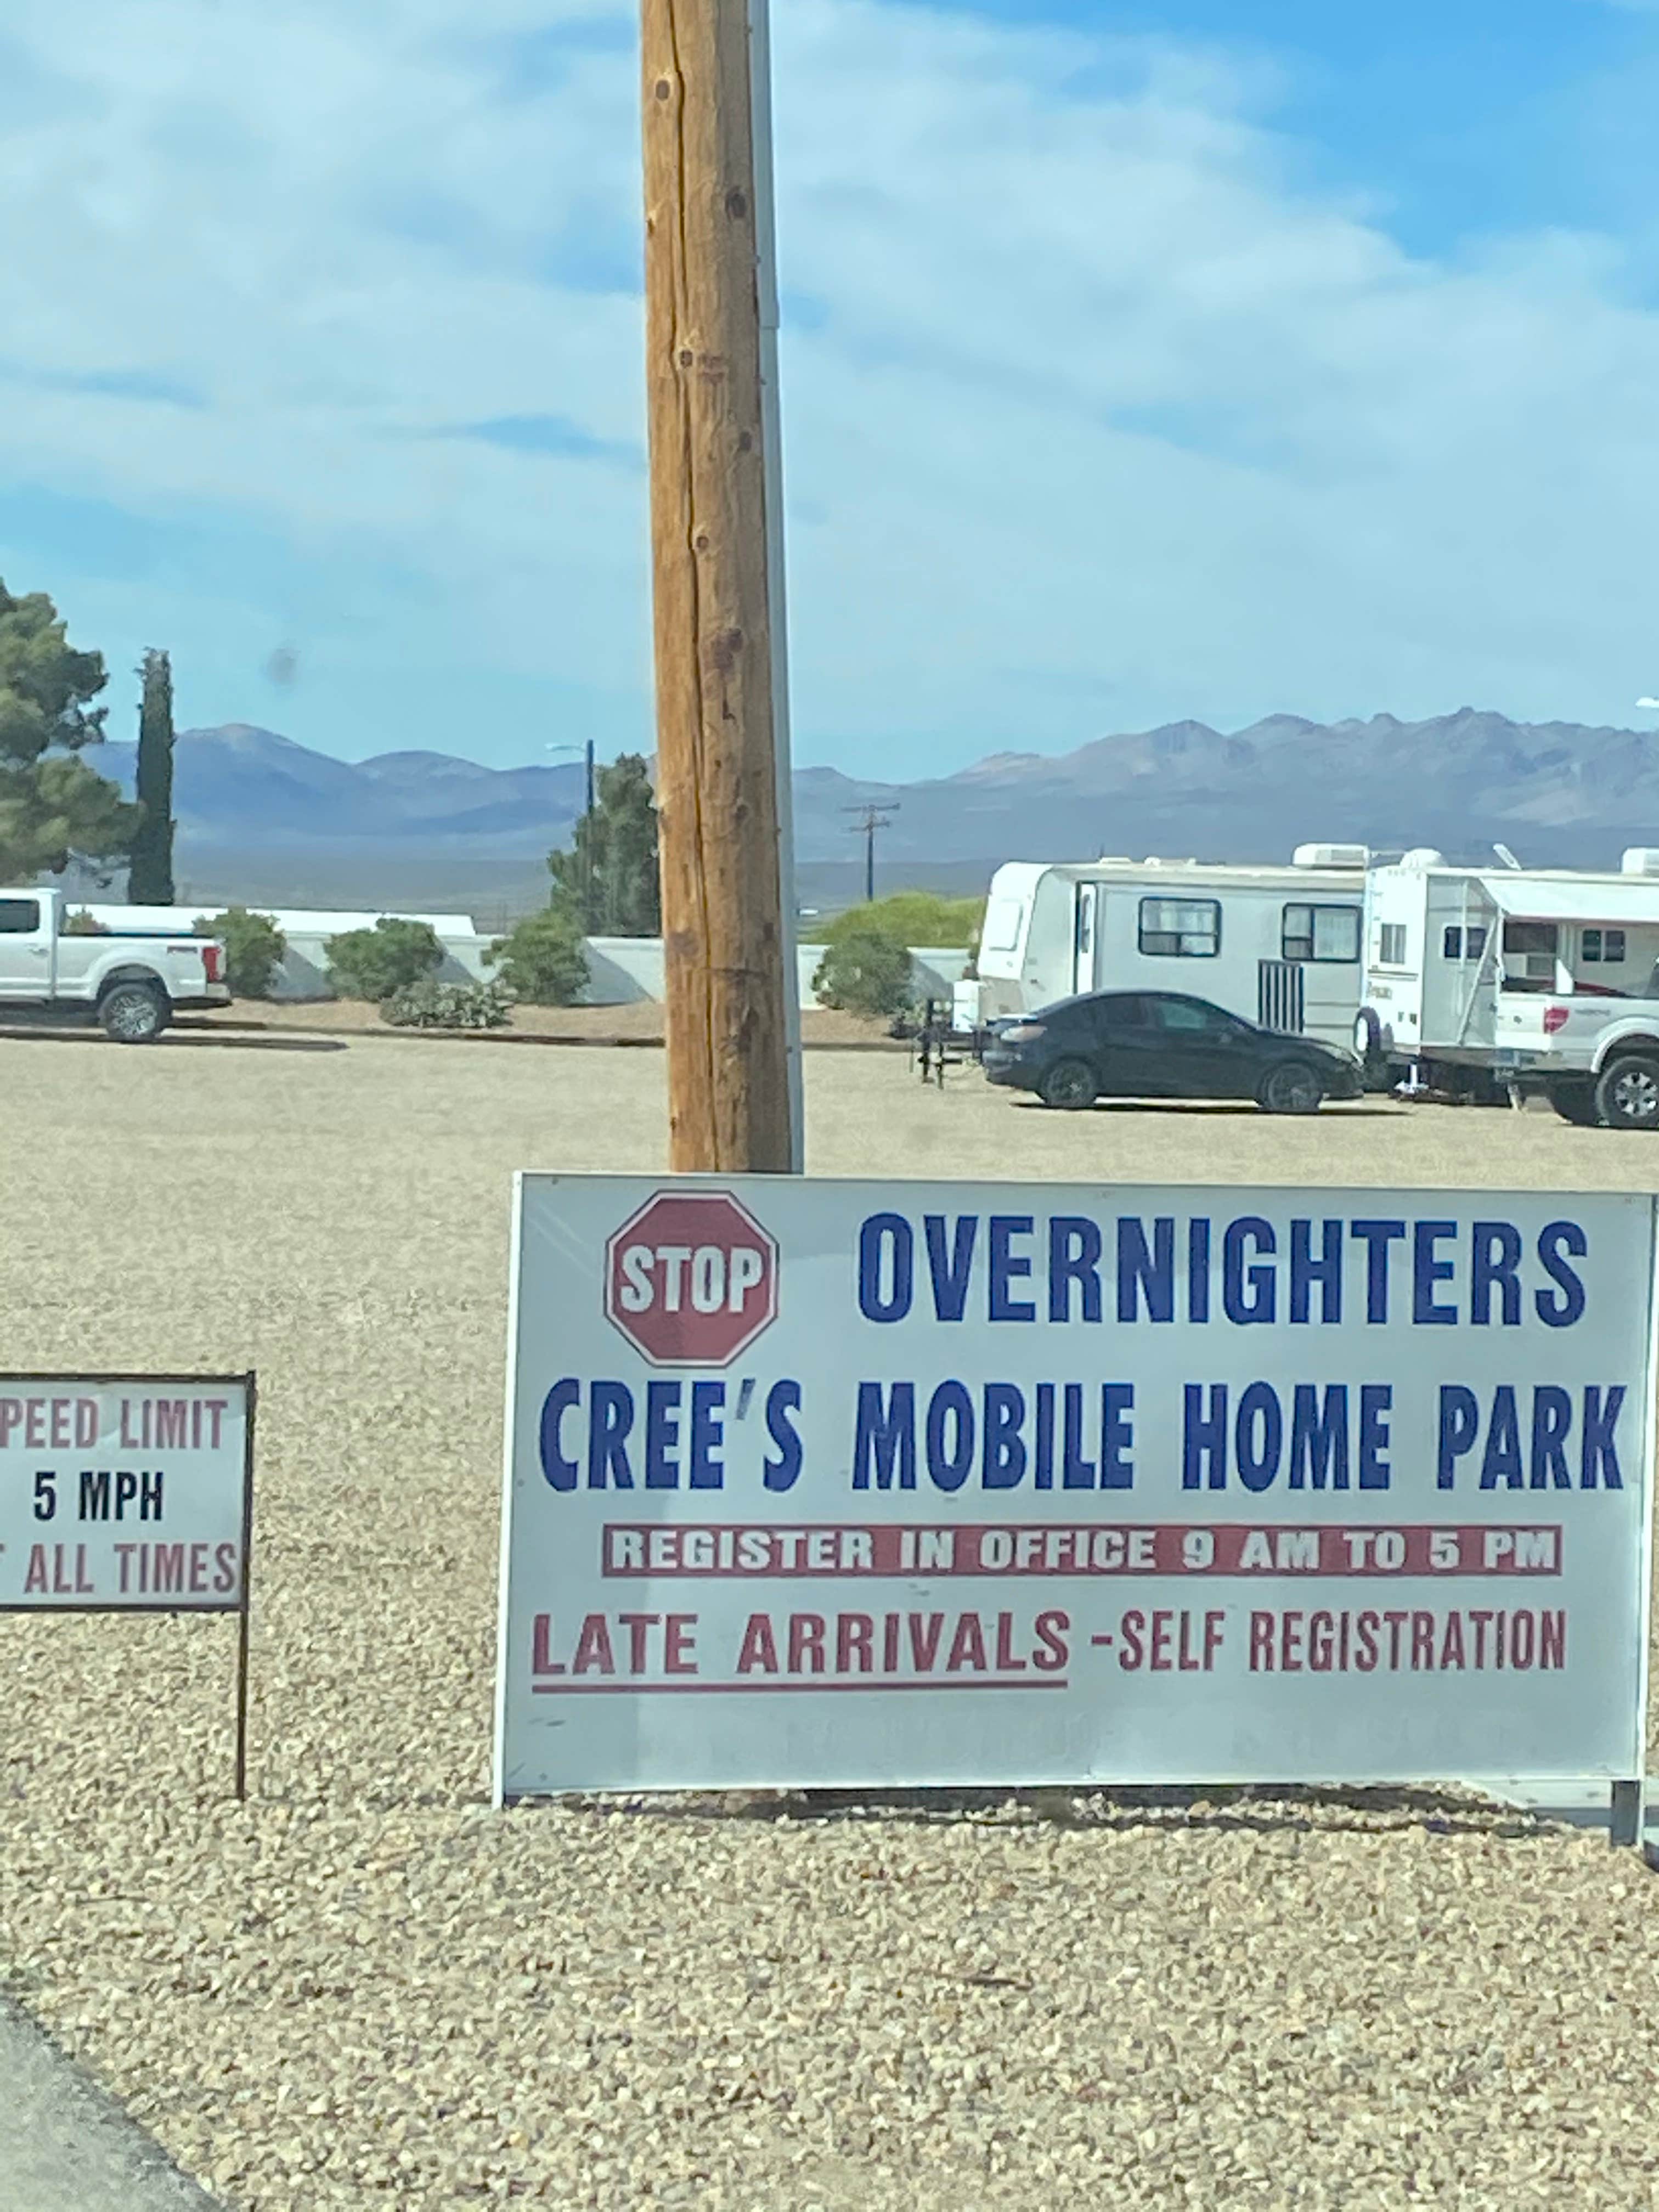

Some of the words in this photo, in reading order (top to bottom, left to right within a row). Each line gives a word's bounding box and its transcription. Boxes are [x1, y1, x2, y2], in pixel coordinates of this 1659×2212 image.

[620, 1244, 763, 1314] STOP
[858, 1211, 1588, 1329] OVERNIGHTERS
[0, 1398, 99, 1449] PEED
[120, 1399, 229, 1449] LIMIT
[539, 1377, 804, 1492] CREE'S
[851, 1379, 1134, 1492] MOBILE
[1182, 1381, 1393, 1492] HOME
[1436, 1384, 1628, 1491] PARK
[33, 1471, 56, 1521] 5
[78, 1471, 165, 1521] MPH
[23, 1544, 94, 1594] ALL
[113, 1543, 236, 1594] TIMES
[611, 1530, 873, 1570] REGISTER
[899, 1530, 955, 1570] IN
[978, 1530, 1156, 1570] OFFICE
[1182, 1530, 1214, 1570] 9
[1239, 1530, 1319, 1570] AM
[1342, 1530, 1406, 1570] TO
[1430, 1530, 1460, 1570] 5
[1482, 1530, 1556, 1570] PM
[532, 1612, 699, 1675] LATE
[735, 1610, 1071, 1675] ARRIVALS
[1248, 1609, 1566, 1672] REGISTRATION
